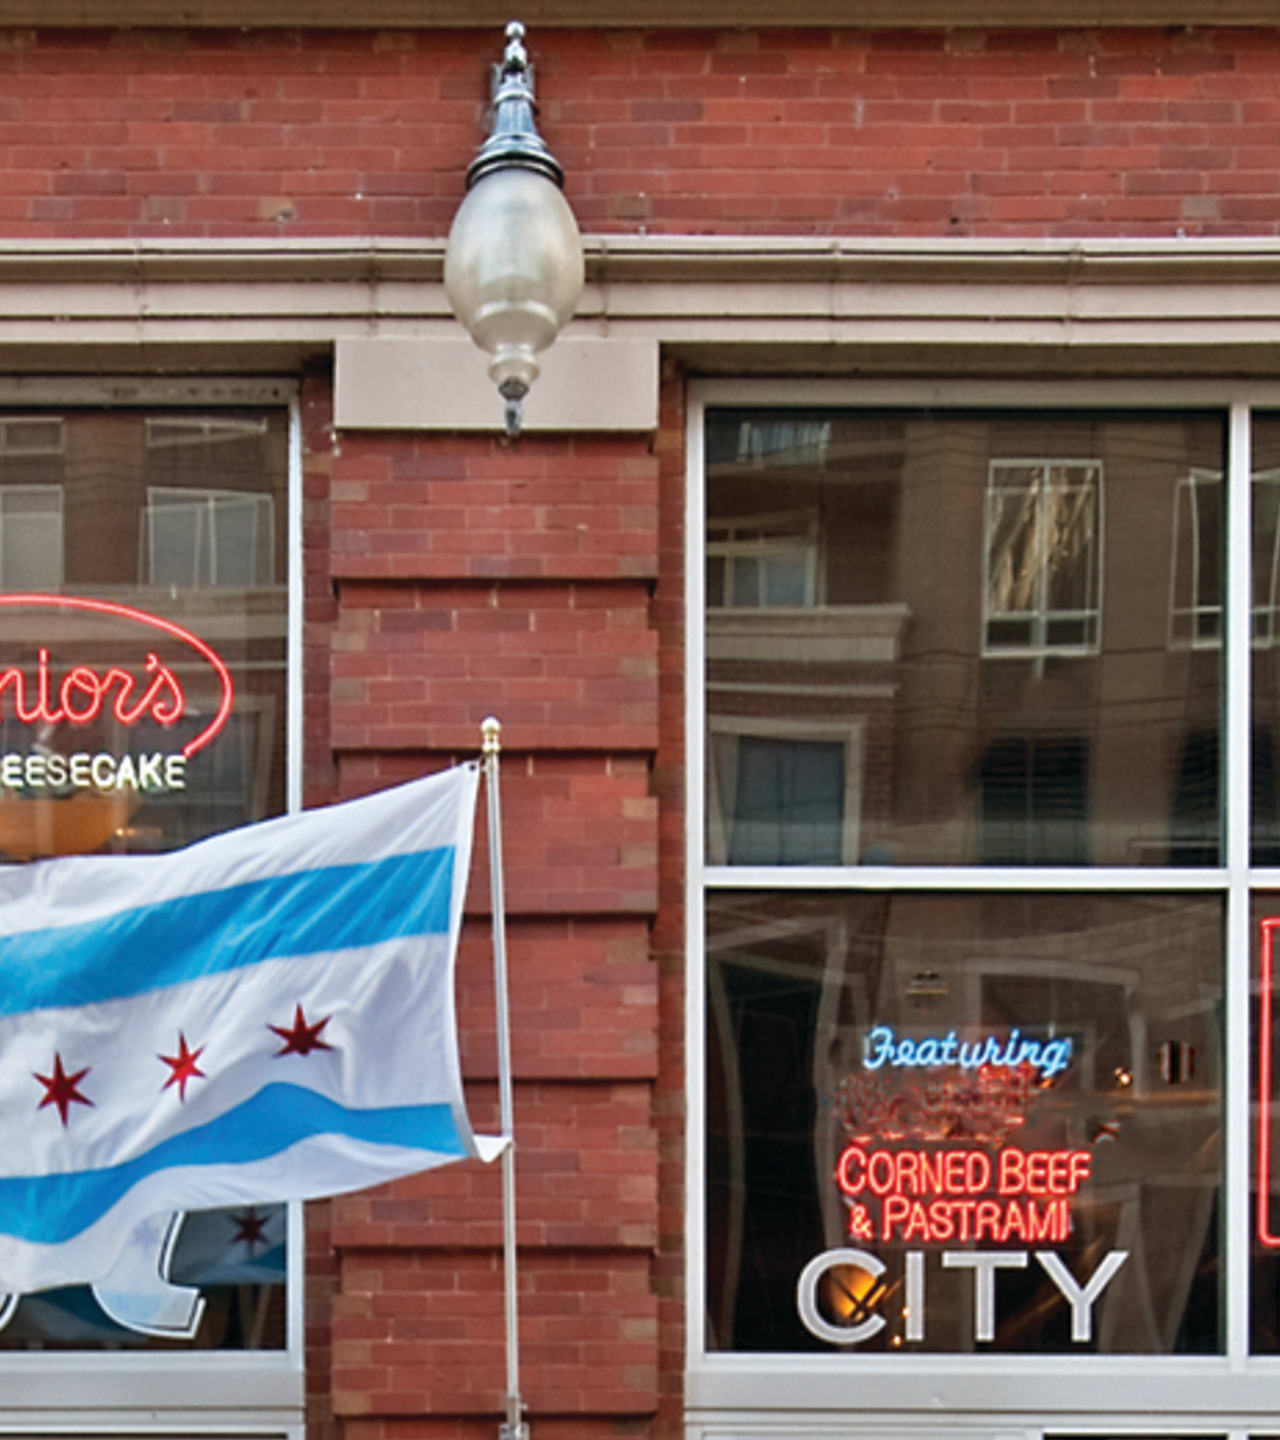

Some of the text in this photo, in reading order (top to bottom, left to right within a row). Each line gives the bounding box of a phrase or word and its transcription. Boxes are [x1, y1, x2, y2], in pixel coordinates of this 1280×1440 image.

[862, 1024, 1073, 1078] Featuring
[837, 1146, 1093, 1197] CORNED BEEF
[849, 1195, 1071, 1242] & PASTRAMI
[797, 1247, 1130, 1345] CITY
